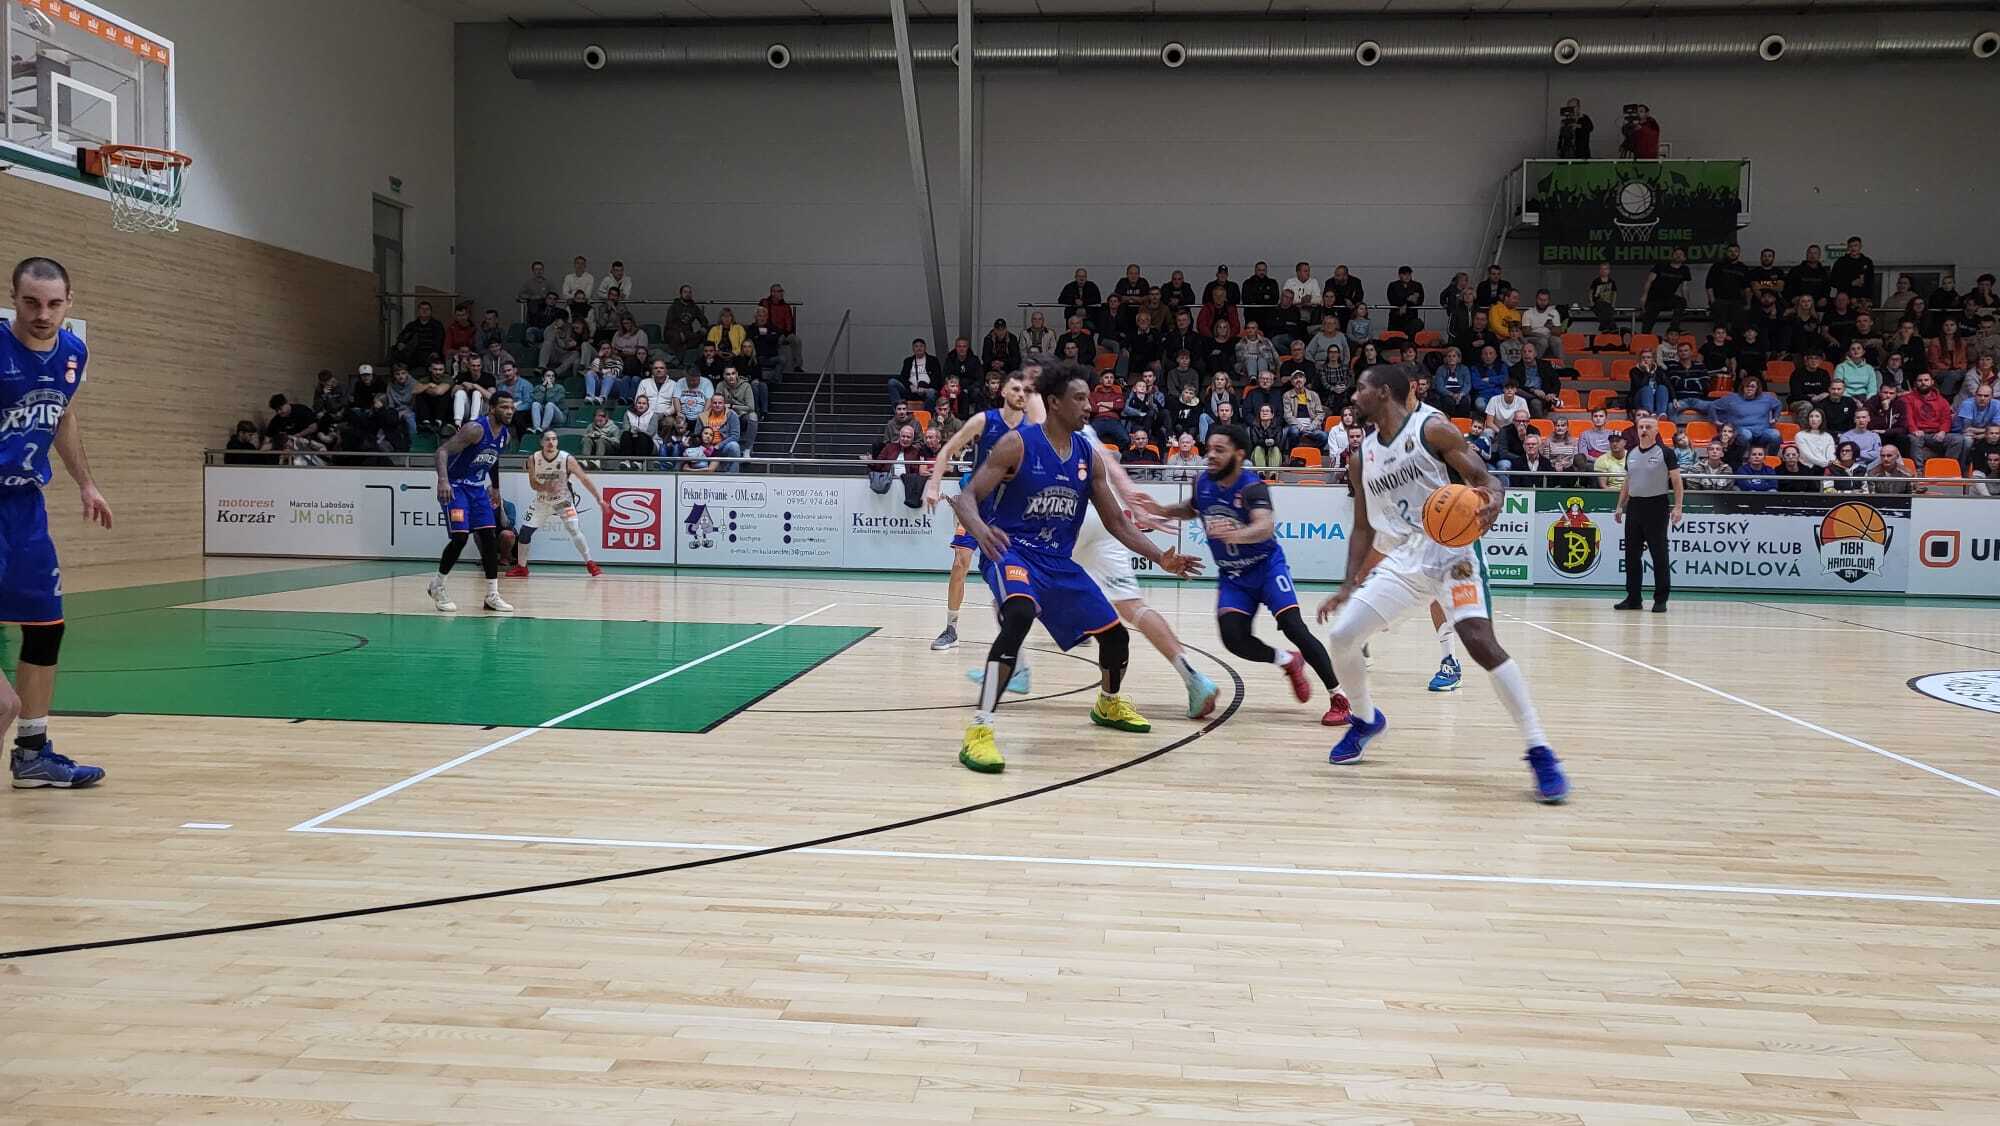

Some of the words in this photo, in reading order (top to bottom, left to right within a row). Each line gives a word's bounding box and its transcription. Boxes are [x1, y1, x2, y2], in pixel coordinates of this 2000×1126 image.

[1590, 229, 1613, 241] MY
[1657, 229, 1694, 241] SME
[1614, 241, 1730, 262] HANDOVÁ
[217, 498, 275, 508] motorest
[289, 499, 318, 508] Marcela
[1397, 499, 1412, 521] 2
[216, 509, 276, 524] Korzár
[290, 510, 311, 524] JM
[317, 510, 353, 525] okná
[400, 511, 448, 526] TELE
[852, 512, 932, 528] Karton.sk
[1489, 521, 1528, 533] cnici
[1671, 520, 1749, 535] MESTSKÝ
[607, 532, 656, 548] PUB
[1485, 543, 1528, 556] OVÁ
[1757, 542, 1802, 555] KLUB
[1840, 541, 1864, 555] MBK
[1489, 567, 1521, 577] ravie!
[1685, 558, 1801, 577] HANDLOVÁ
[1275, 574, 1292, 593] 0
